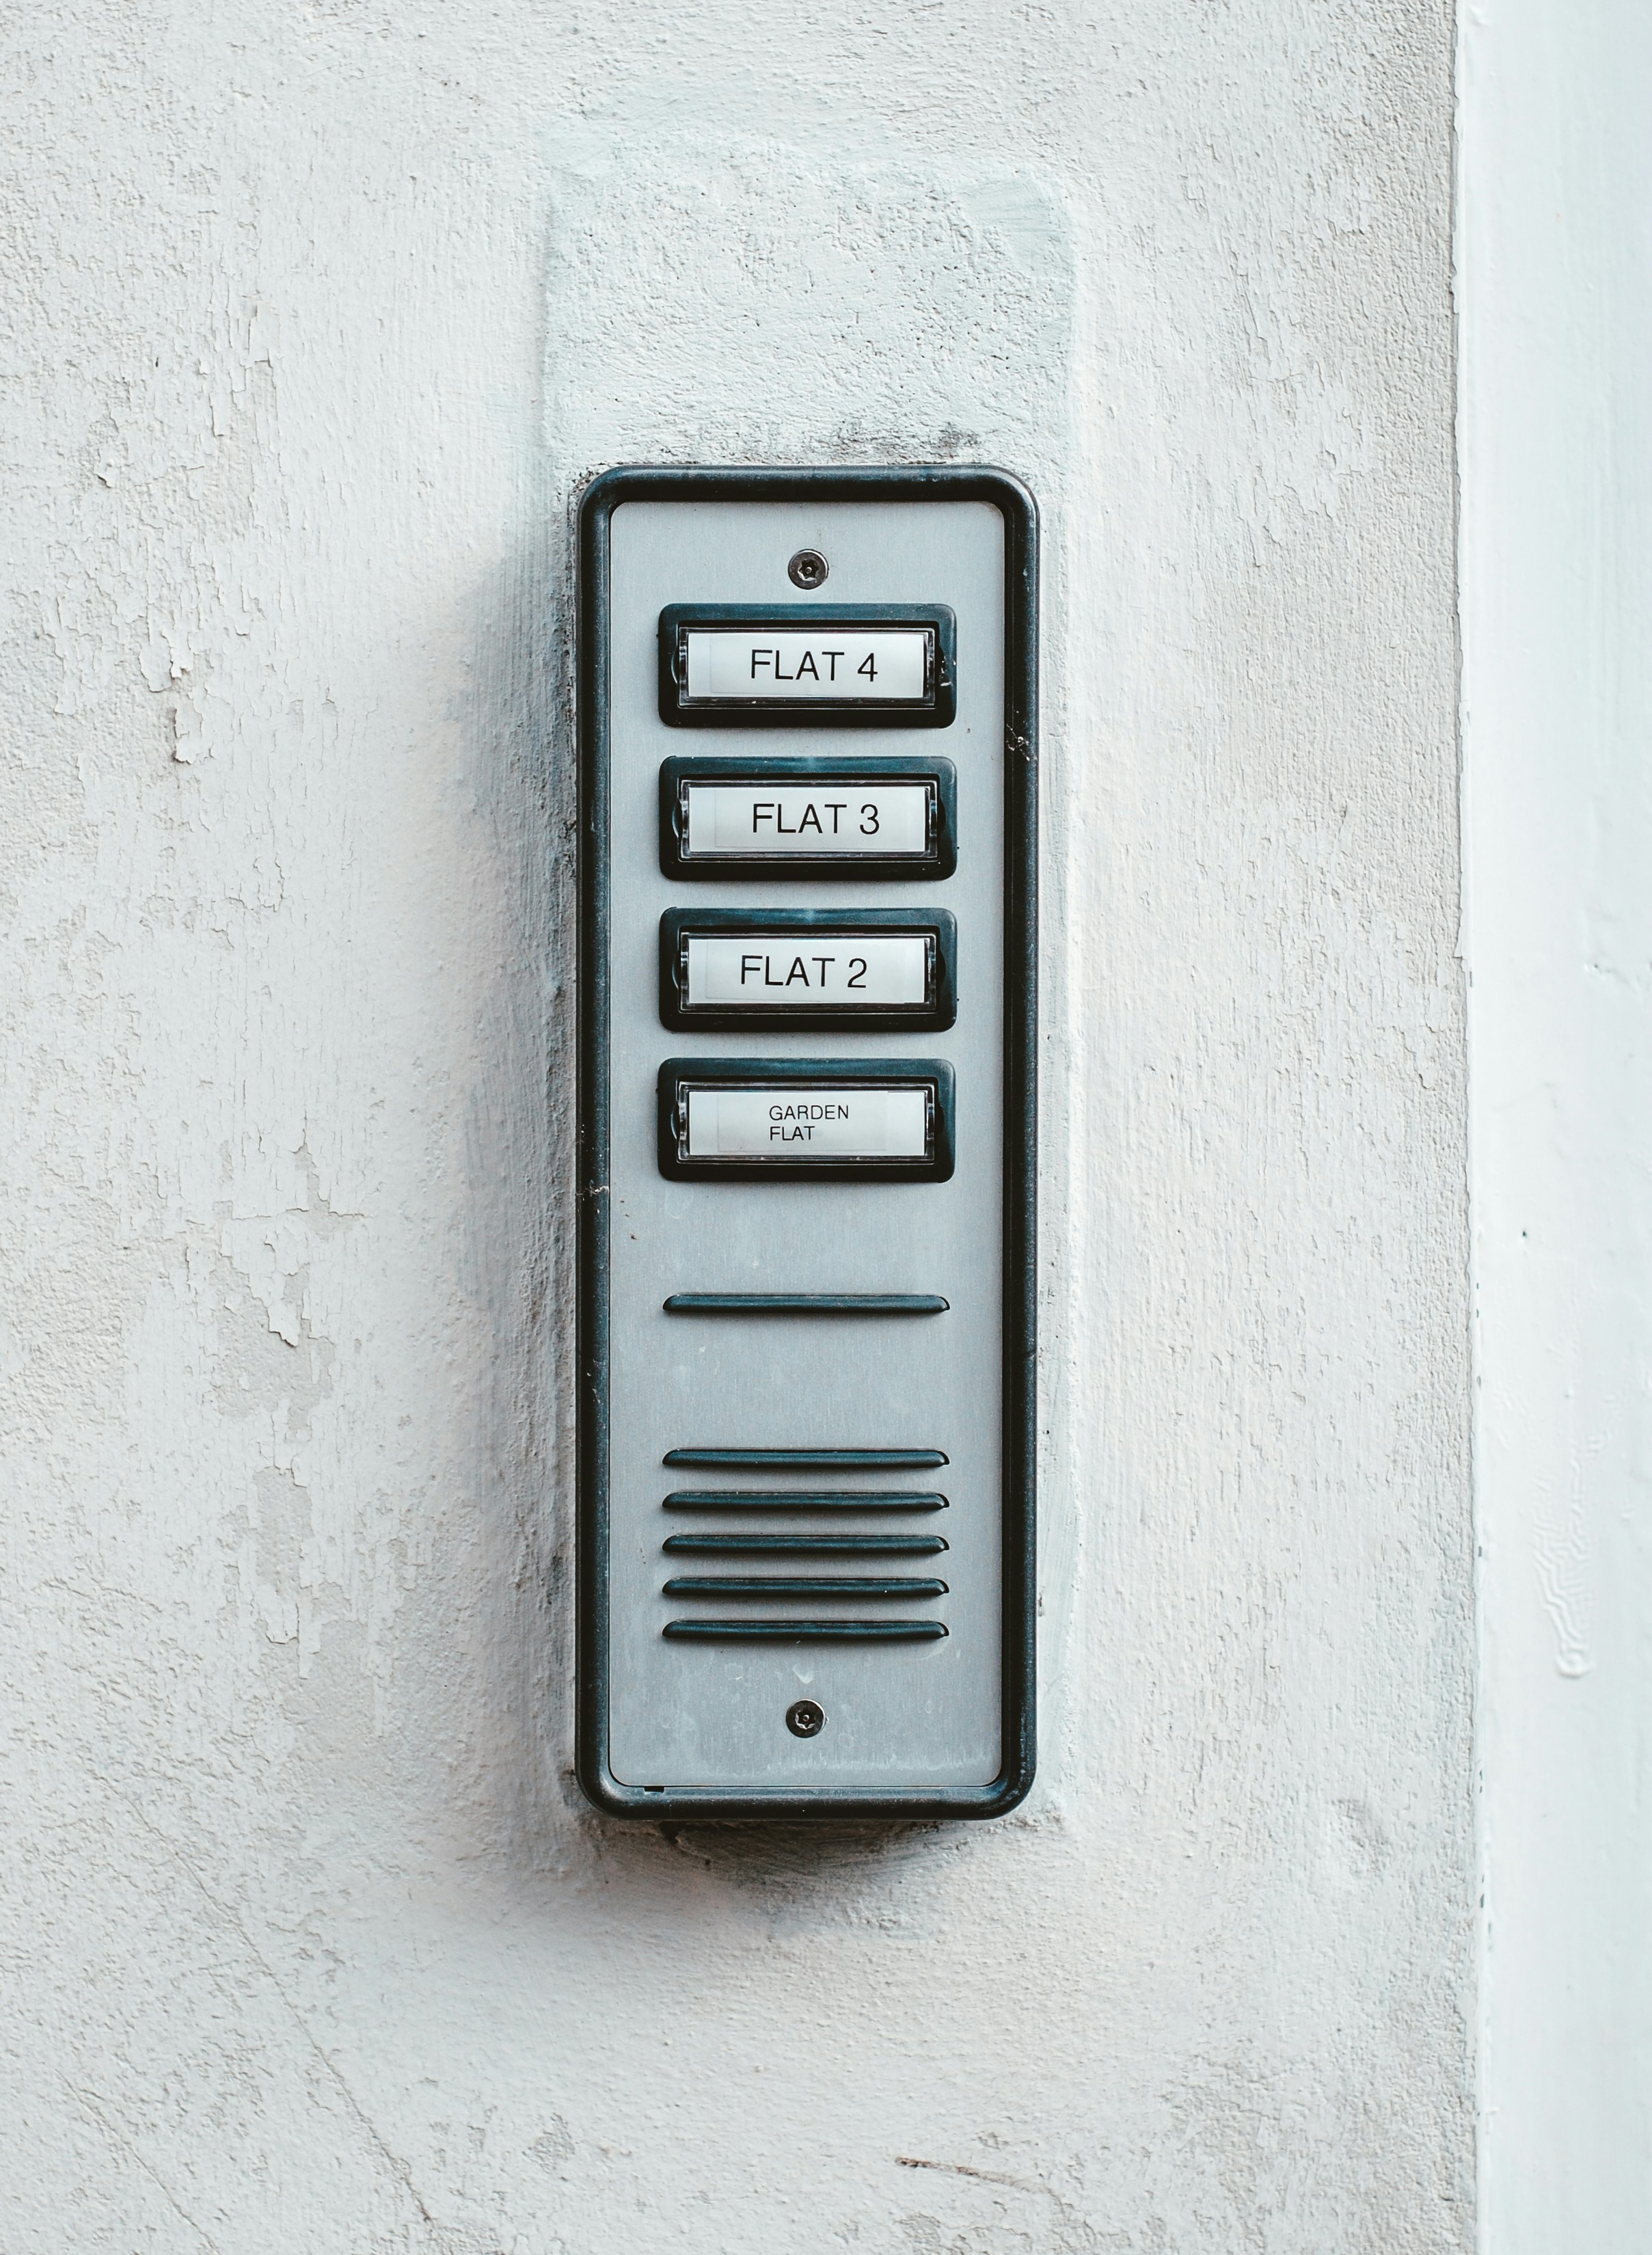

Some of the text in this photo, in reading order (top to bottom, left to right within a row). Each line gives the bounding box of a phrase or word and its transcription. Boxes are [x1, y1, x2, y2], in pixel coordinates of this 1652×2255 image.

[751, 649, 878, 682] FLAT 4
[753, 803, 880, 835] FLAT 3
[741, 955, 867, 988] FLAT 2
[769, 1105, 849, 1121] GARDEN
[770, 1125, 815, 1141] FLAT
